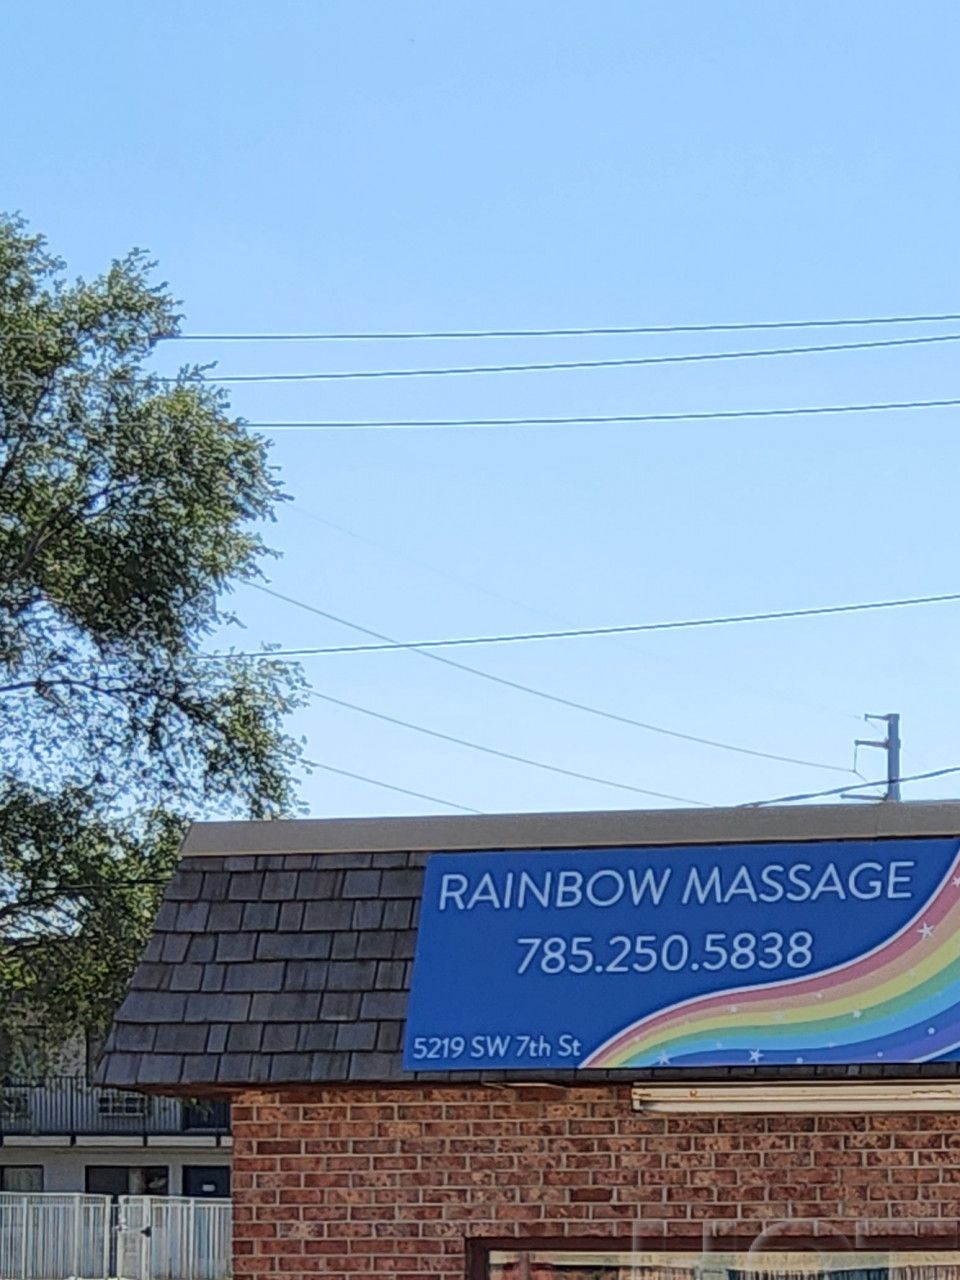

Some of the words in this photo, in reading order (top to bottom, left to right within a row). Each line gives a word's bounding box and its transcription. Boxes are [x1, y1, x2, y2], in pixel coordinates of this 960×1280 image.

[438, 868, 672, 911] RAINBOW
[682, 860, 915, 905] MASSAGE
[516, 931, 815, 975] 785.250.5838
[413, 1036, 466, 1059] 5219
[470, 1035, 511, 1058] SW
[516, 1034, 551, 1058] 7th
[557, 1034, 582, 1057] St
